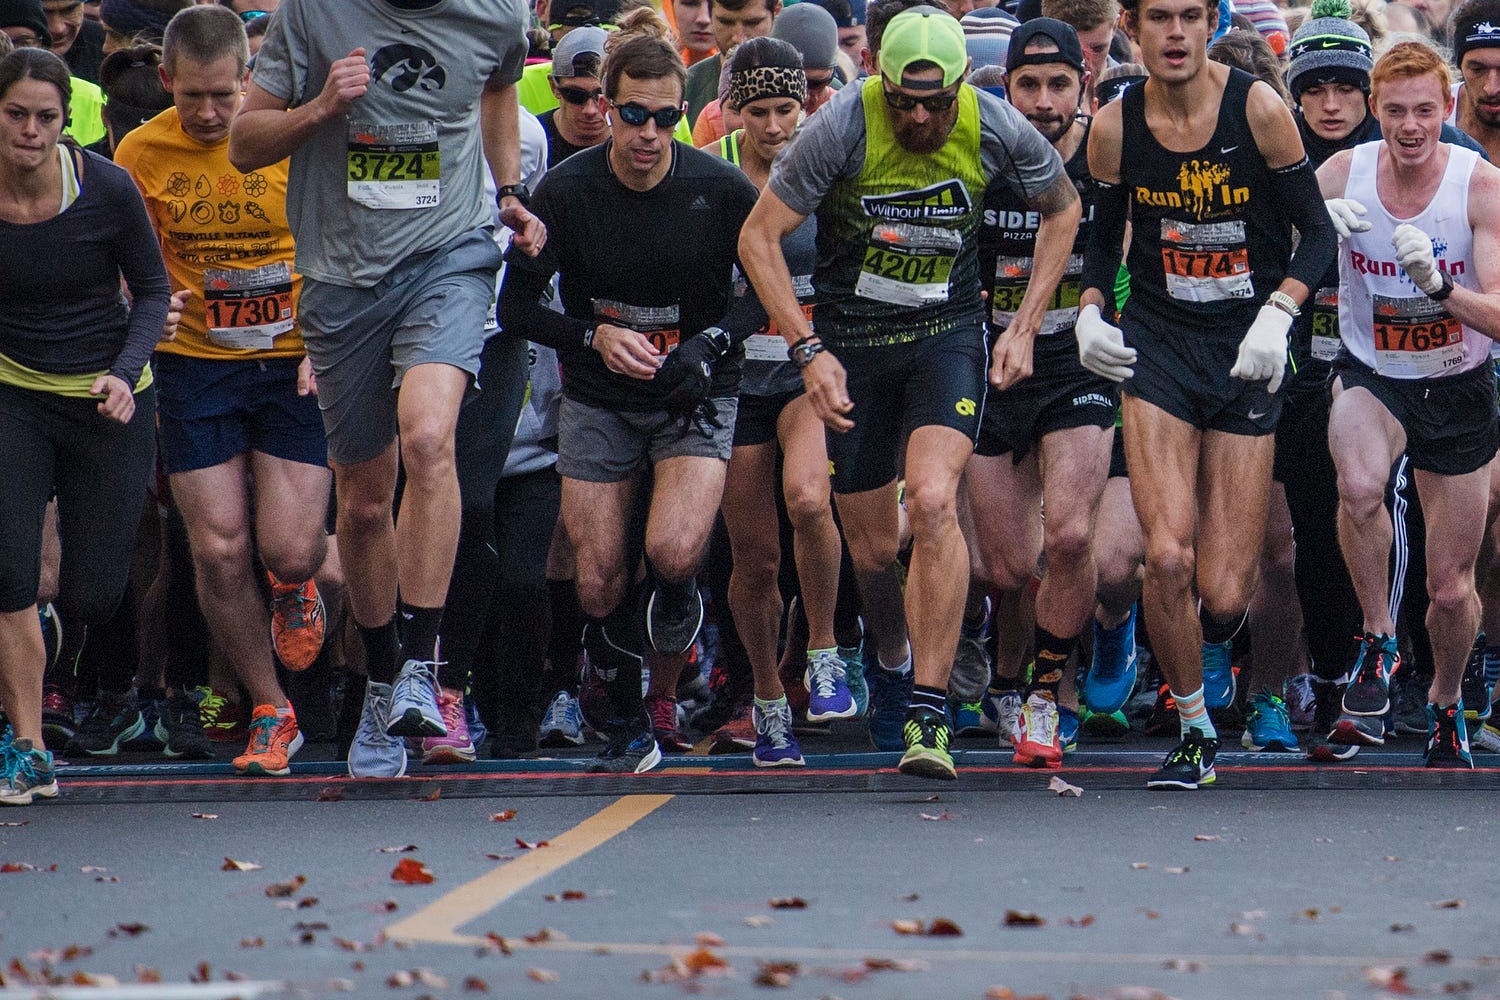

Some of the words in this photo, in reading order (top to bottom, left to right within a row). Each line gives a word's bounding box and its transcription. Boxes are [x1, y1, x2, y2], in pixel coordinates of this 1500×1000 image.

[350, 153, 424, 181] 3724
[416, 195, 437, 205] 3724
[1136, 186, 1181, 208] Run
[1221, 185, 1250, 205] In
[870, 202, 920, 218] Without
[1003, 231, 1033, 240] PIZZA
[865, 250, 938, 283] 4204
[1165, 251, 1233, 276] 1774
[1350, 250, 1396, 276] Run
[1230, 287, 1251, 297] 1774
[208, 296, 280, 328] 1730
[1376, 323, 1448, 351] 1769
[1442, 355, 1463, 368] 1769
[1072, 393, 1113, 406] SIDEWALL
